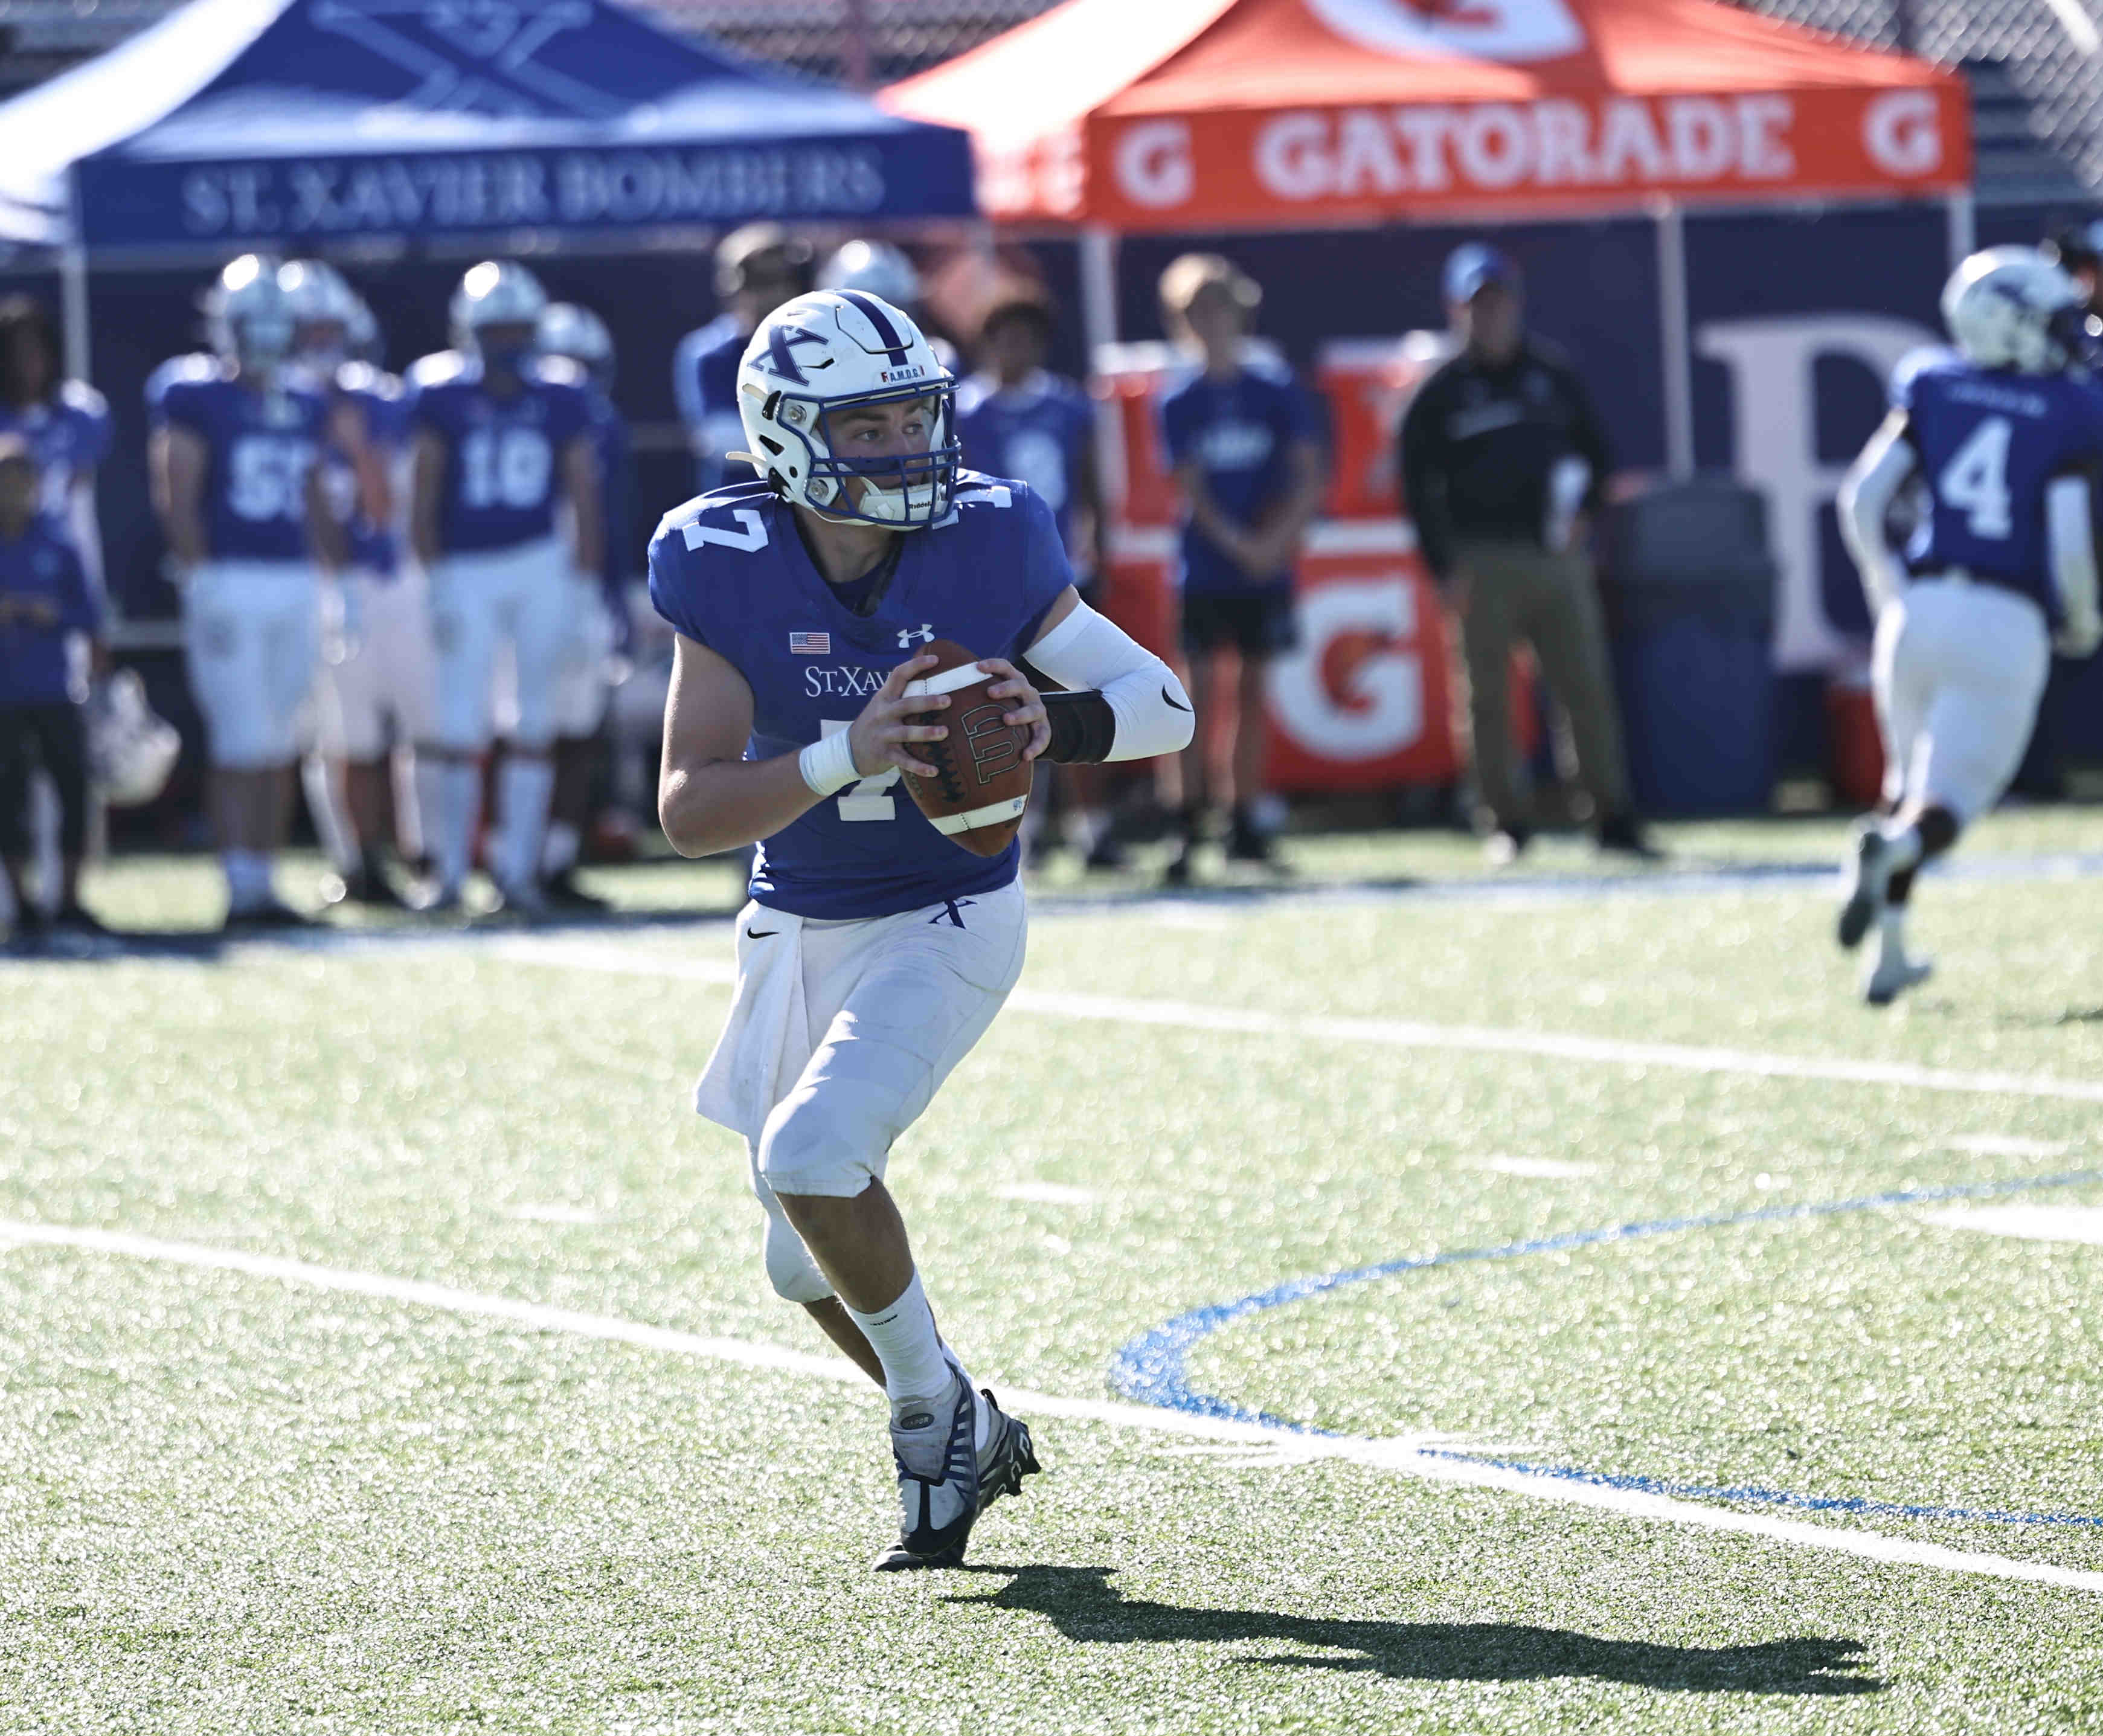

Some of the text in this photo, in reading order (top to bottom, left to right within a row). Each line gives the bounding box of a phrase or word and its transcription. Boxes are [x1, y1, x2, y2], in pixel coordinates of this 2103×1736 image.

[1113, 121, 1194, 209] G
[1254, 94, 1797, 201] GATORADE
[1861, 88, 1942, 177] G
[289, 155, 547, 233] XAVIER
[556, 146, 886, 222] BOMBERS
[461, 425, 552, 511] 10
[1936, 415, 2013, 540] 4
[682, 509, 769, 553] 7
[1264, 574, 1427, 761] G
